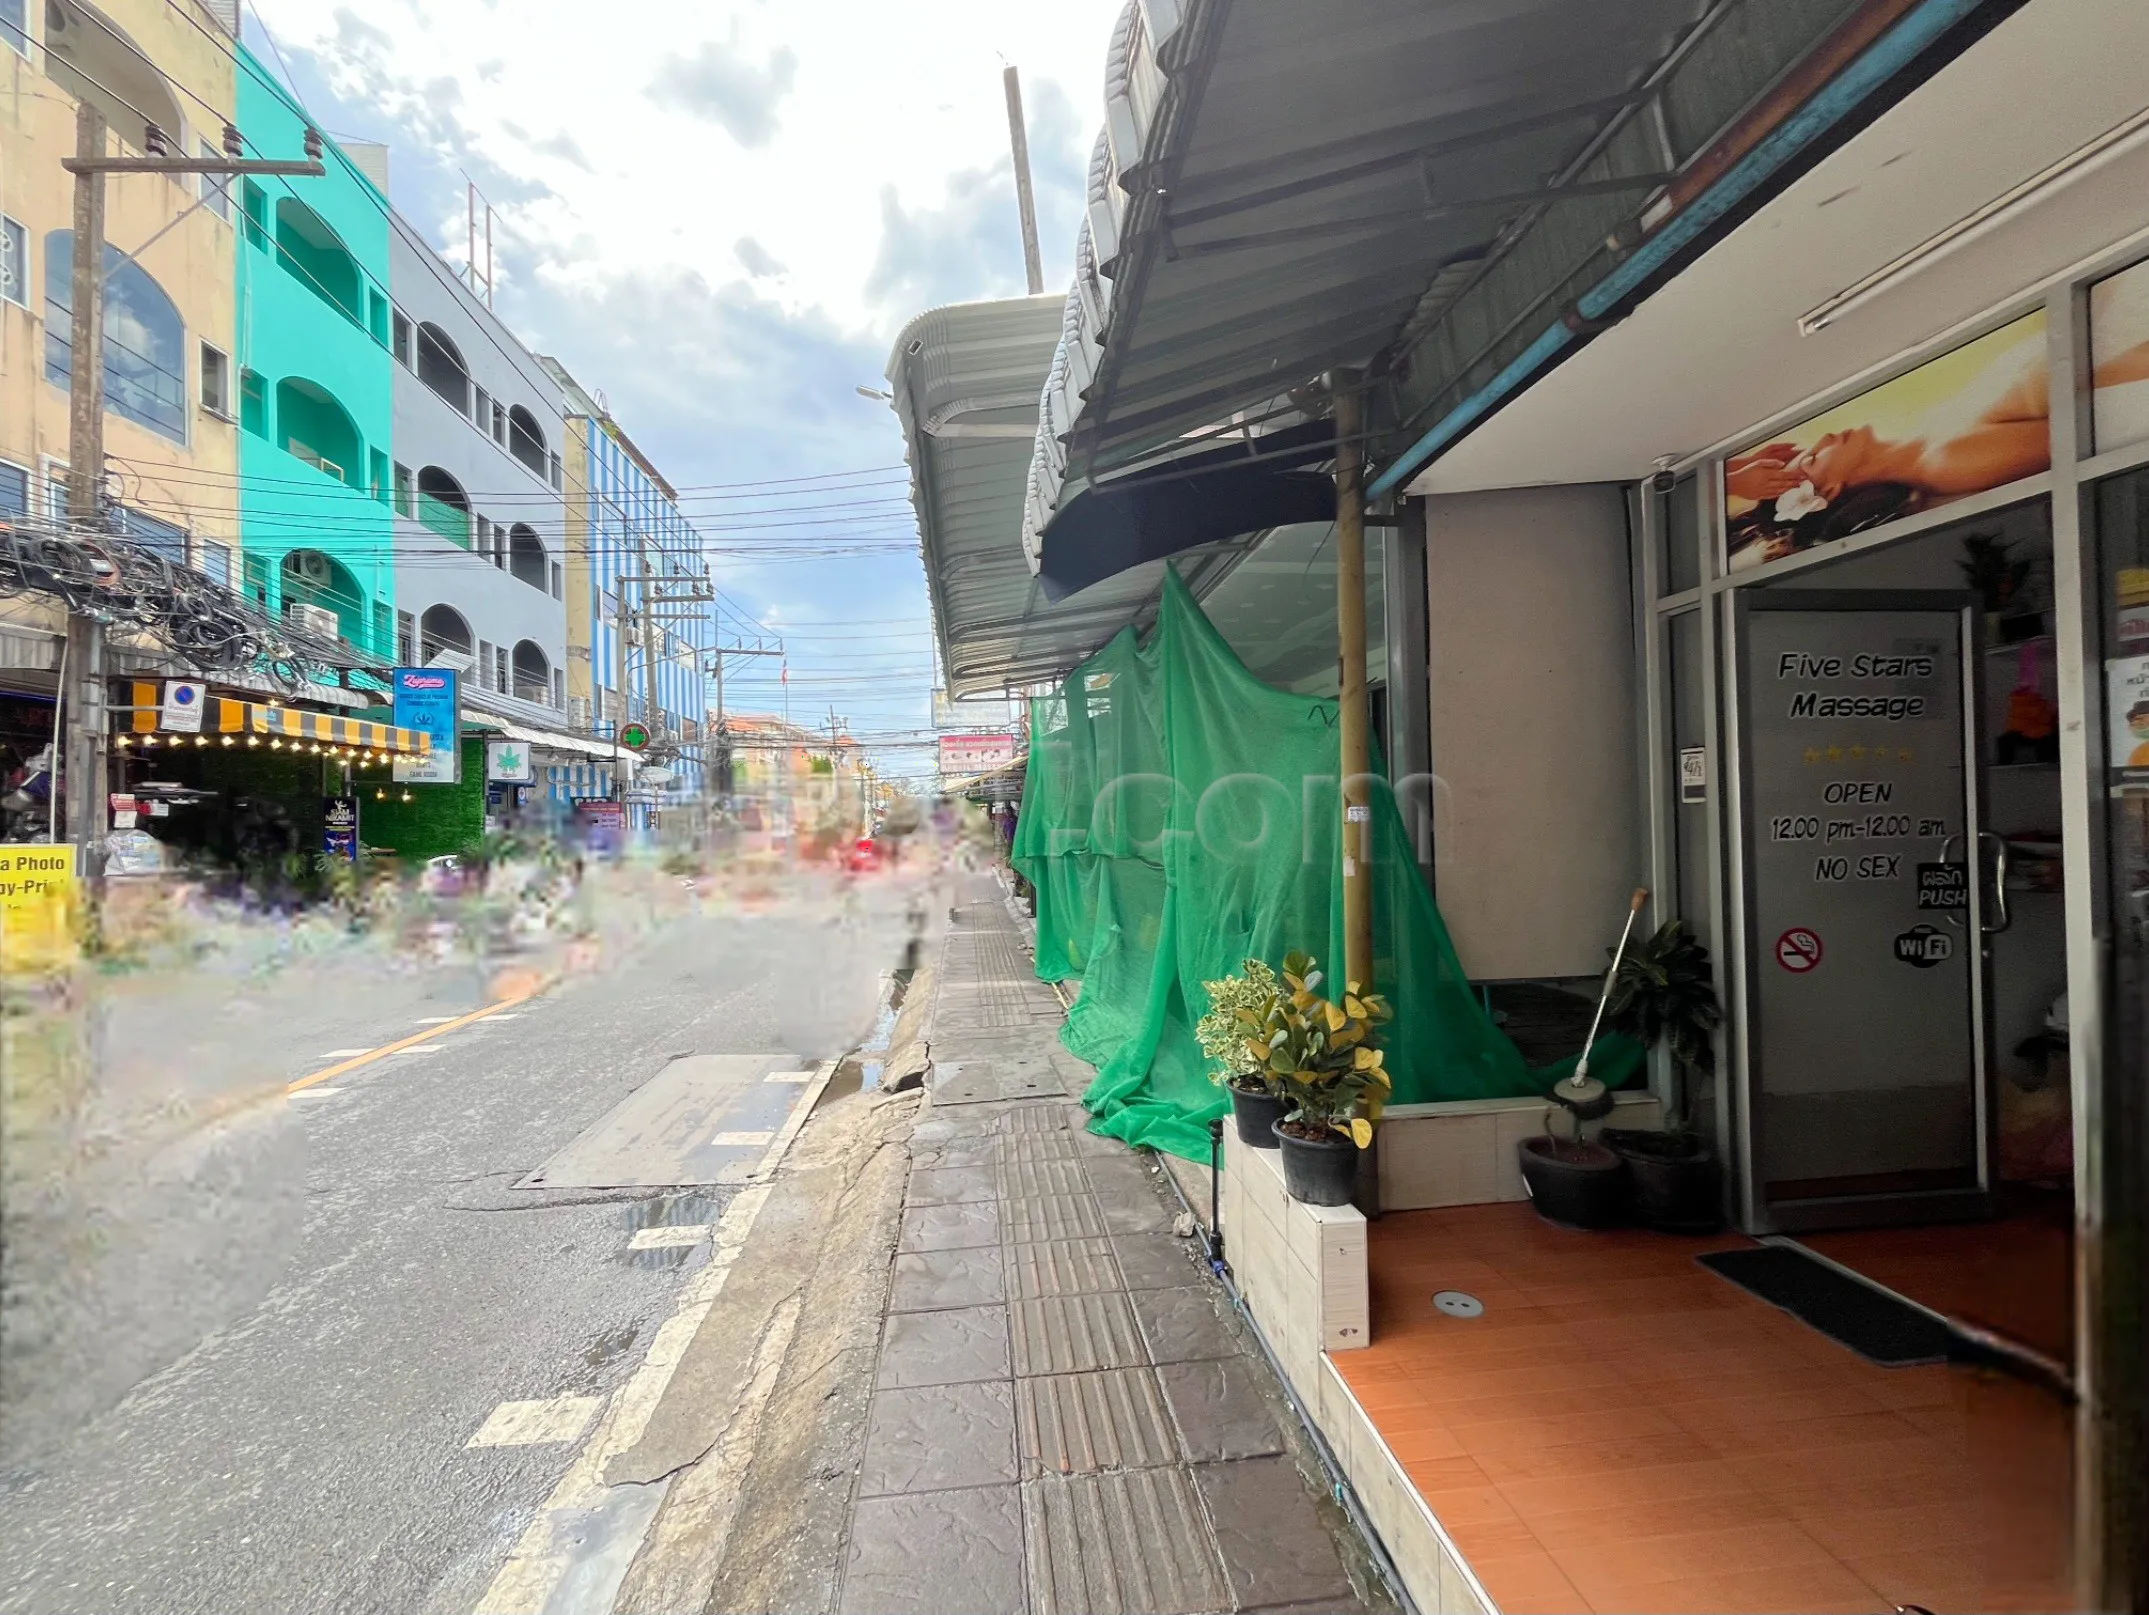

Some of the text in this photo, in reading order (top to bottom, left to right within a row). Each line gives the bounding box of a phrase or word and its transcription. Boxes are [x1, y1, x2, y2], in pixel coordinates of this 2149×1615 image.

[1778, 653, 1932, 679] Five Stars
[1789, 692, 1924, 721] Massage
[1824, 782, 1893, 804] OPEN
[1772, 816, 1819, 840] 12.00
[16, 857, 65, 871] Photo
[1815, 855, 1901, 881] NO SEX
[1919, 888, 1968, 906] PUSH
